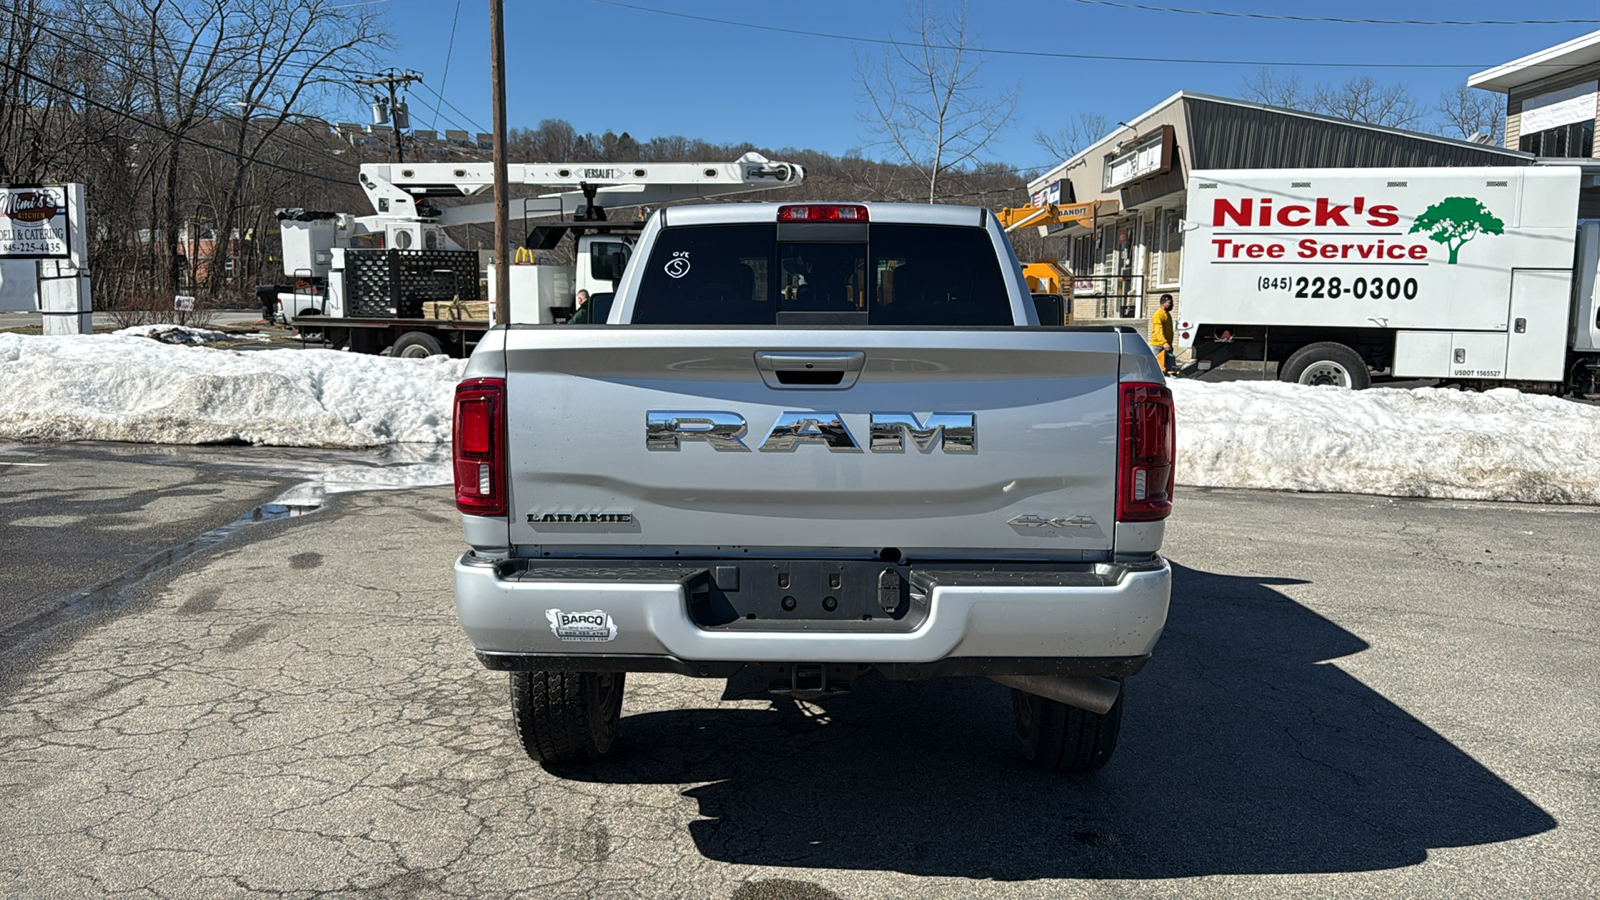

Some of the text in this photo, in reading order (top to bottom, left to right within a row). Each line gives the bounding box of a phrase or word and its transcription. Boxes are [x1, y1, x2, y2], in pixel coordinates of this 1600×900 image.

[584, 168, 615, 179] VERSALIFT
[0, 191, 44, 214] Mimi's
[1057, 207, 1087, 217] BANDIT
[1212, 197, 1400, 227] Nick's
[17, 229, 24, 240] &
[25, 228, 64, 241] CATERING
[3, 243, 61, 253] 845-225-4435
[1211, 239, 1429, 260] Tree Service
[1257, 276, 1419, 300] (845) 228-0300
[646, 410, 978, 453] RAM
[526, 513, 632, 524] LARAMIE
[562, 615, 604, 626] BARCO
